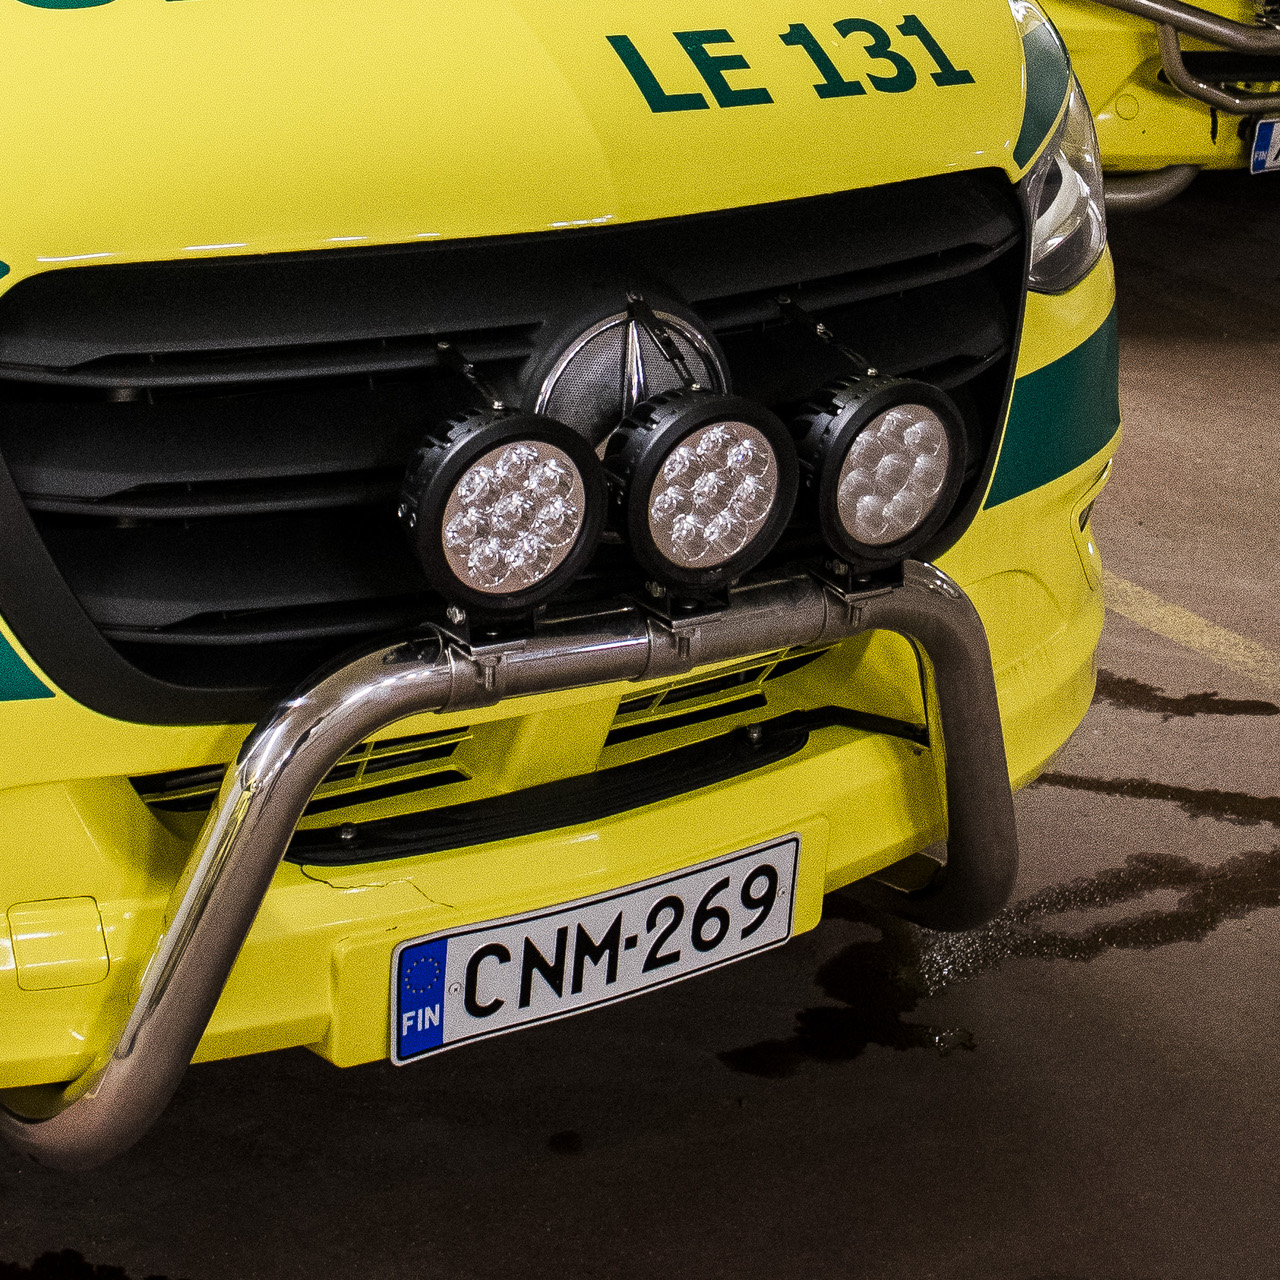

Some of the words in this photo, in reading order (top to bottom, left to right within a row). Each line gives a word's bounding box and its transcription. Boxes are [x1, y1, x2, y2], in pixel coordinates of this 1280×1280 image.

[606, 25, 773, 114] LE
[777, 13, 975, 100] 131
[463, 863, 780, 1019] CNM-269
[401, 1002, 441, 1036] FIN
